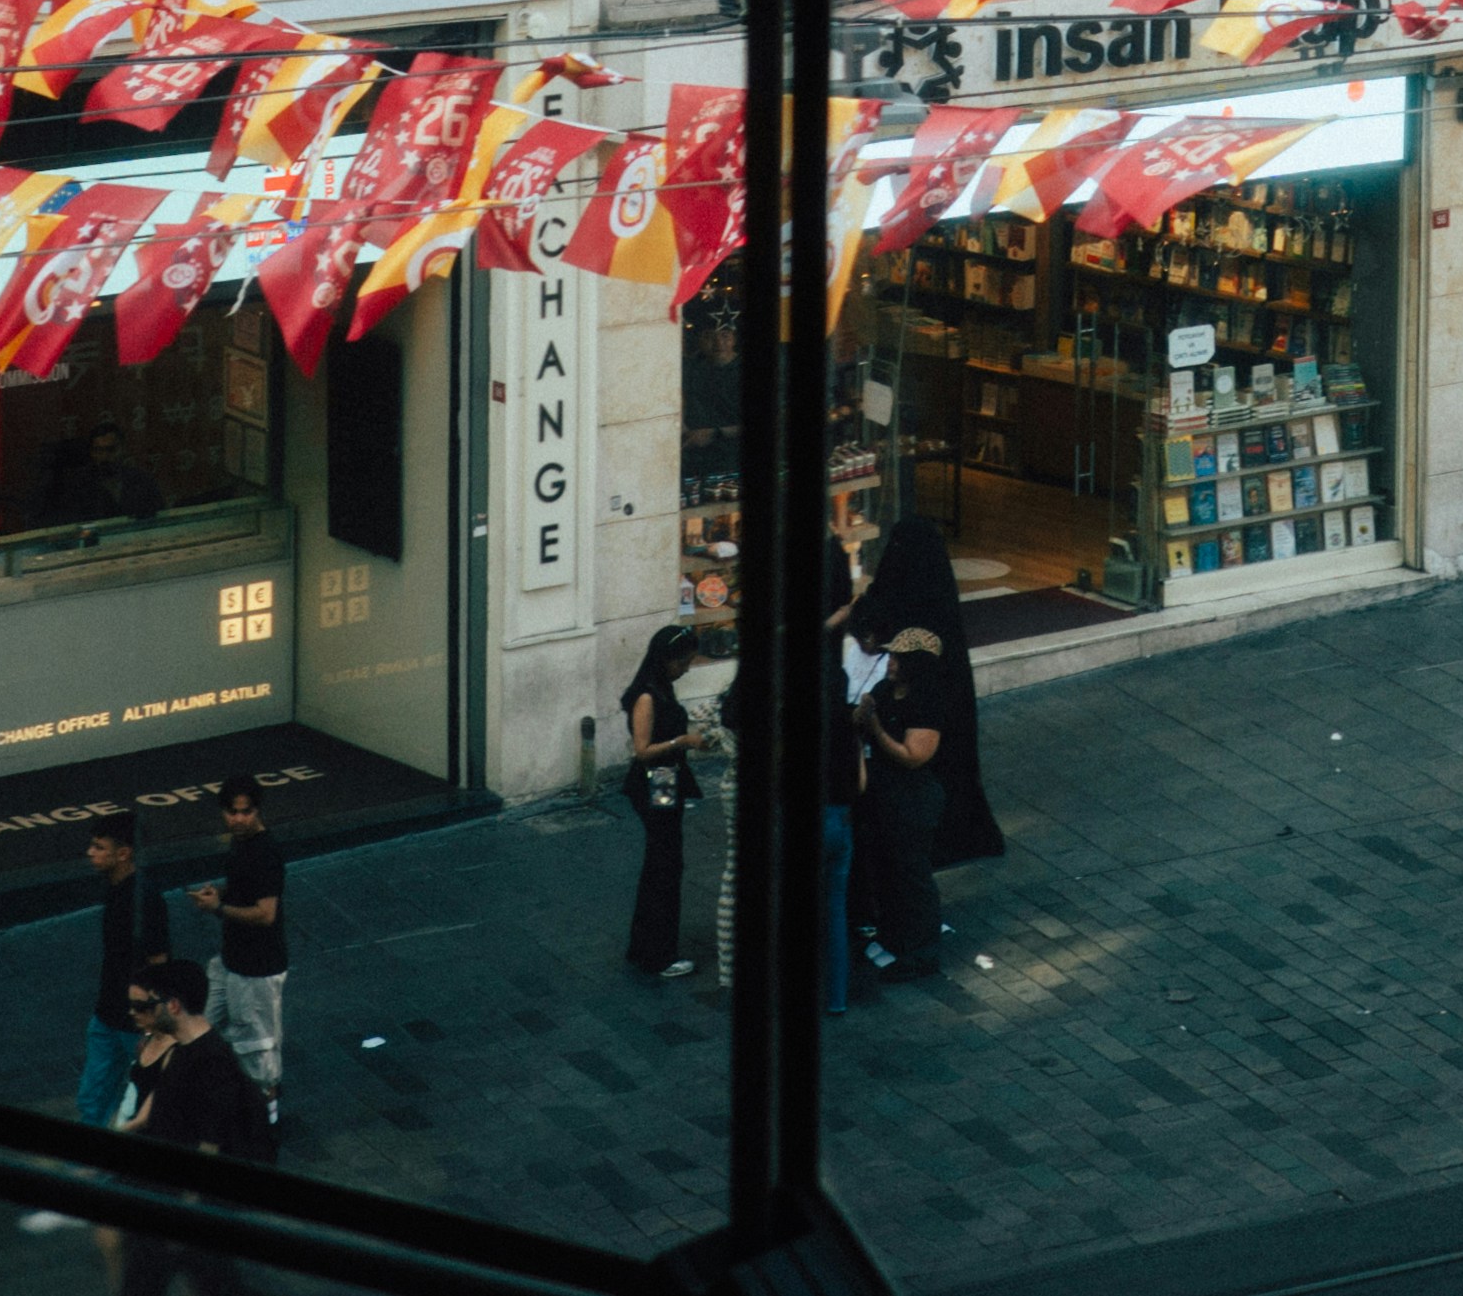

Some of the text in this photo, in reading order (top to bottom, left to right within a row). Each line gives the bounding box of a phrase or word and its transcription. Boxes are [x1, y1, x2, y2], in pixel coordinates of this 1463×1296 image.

[414, 96, 473, 147] 26
[533, 93, 567, 565] ECHANGE
[56, 711, 111, 736] OFFICE
[122, 700, 168, 724] ALTIN
[170, 692, 216, 715] ALINIR
[219, 682, 272, 706] SATILIR
[135, 763, 326, 808] OFFCE
